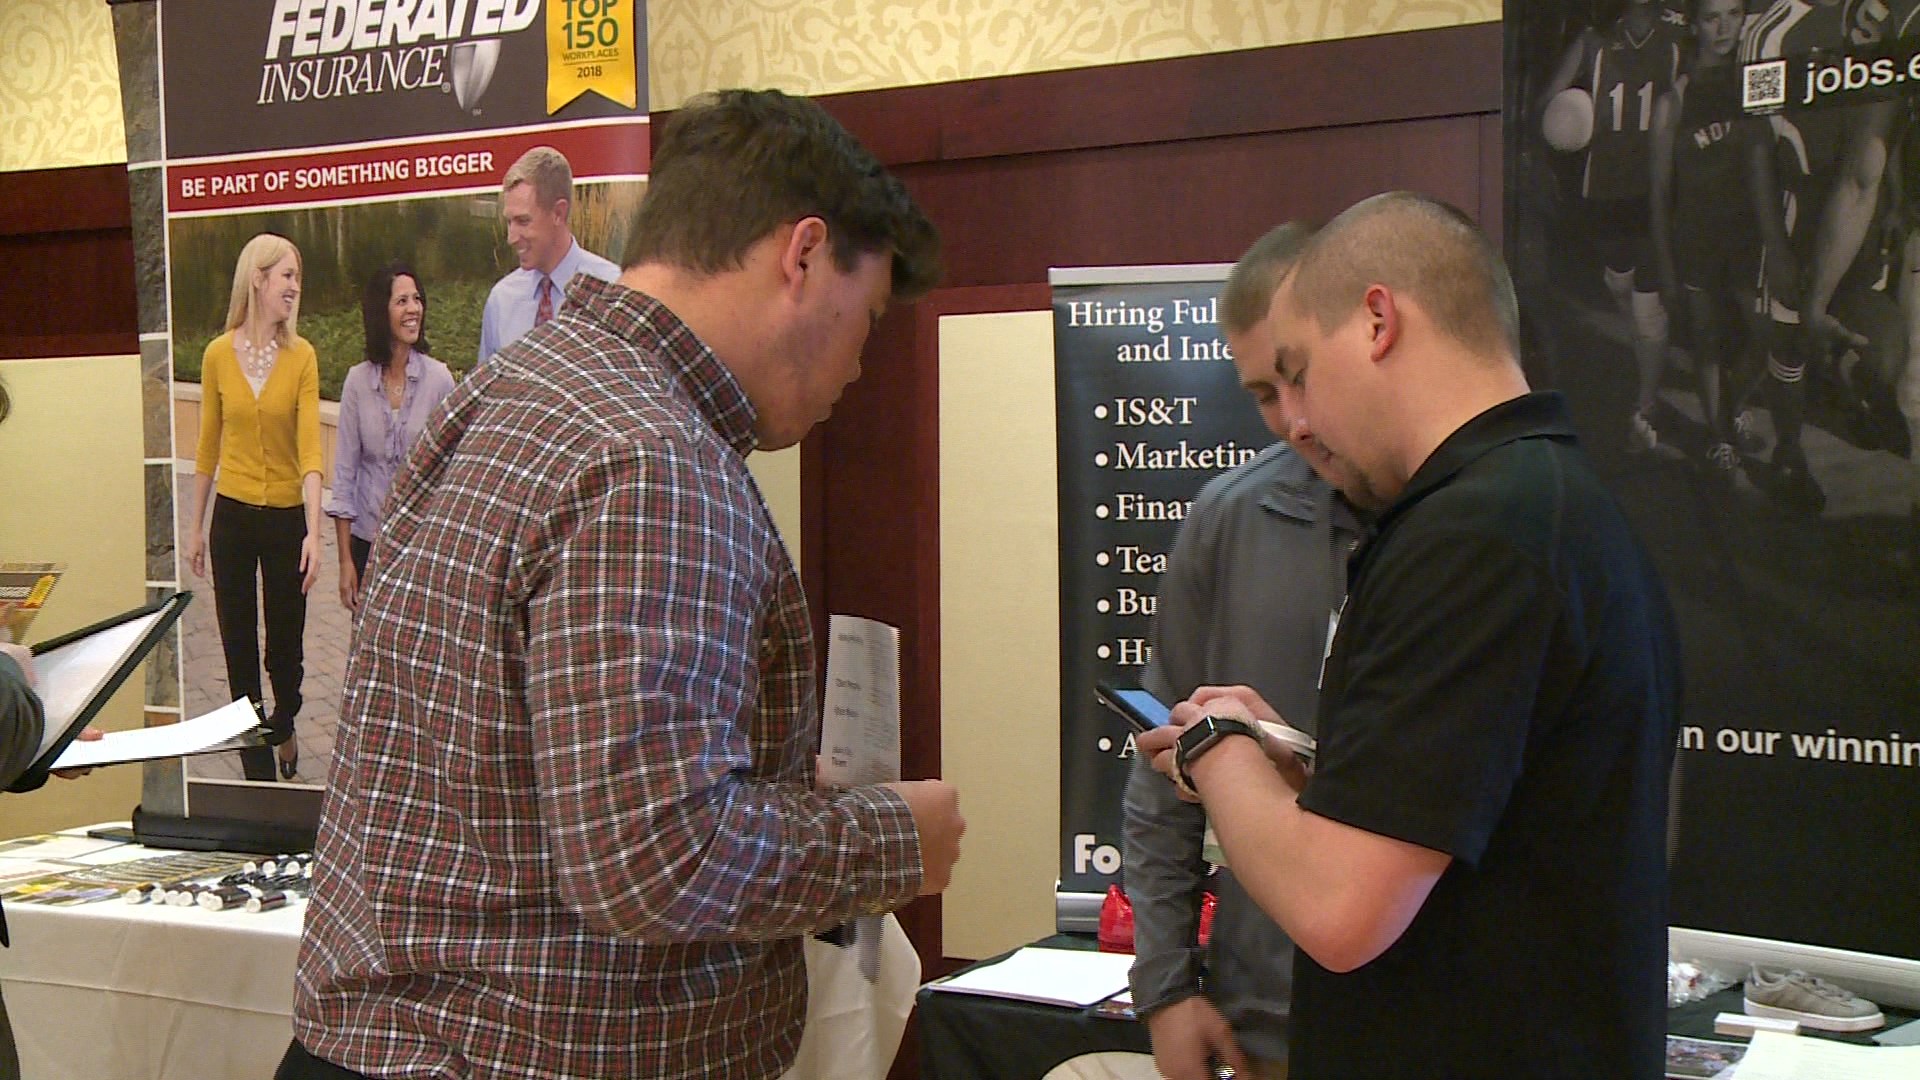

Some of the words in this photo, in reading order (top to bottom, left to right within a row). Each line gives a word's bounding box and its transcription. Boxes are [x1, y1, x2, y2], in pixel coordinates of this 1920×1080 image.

[561, 0, 618, 20] TOP
[265, 0, 541, 60] FEDERATED
[562, 18, 619, 50] 150
[562, 48, 619, 60] WORKPLACES
[257, 44, 449, 105] INSURANCE
[577, 66, 602, 78] 2018
[1803, 55, 1920, 104] jobs.e
[1609, 82, 1653, 131] 11
[181, 178, 206, 198] BE
[211, 173, 259, 196] PART
[264, 170, 290, 192] OF
[295, 159, 409, 190] SOMETHING
[415, 151, 494, 178] BIGGER
[1068, 300, 1164, 333] Hiring
[1172, 297, 1219, 325] Ful
[1117, 335, 1171, 363] and
[1179, 336, 1234, 361] Inte
[1114, 397, 1198, 426] IS&T
[1115, 440, 1264, 470] Marketin
[1116, 546, 1168, 574] Tea
[1116, 588, 1158, 616] Bu
[1716, 728, 1782, 755] our
[1791, 728, 1920, 767] winnin
[1074, 834, 1121, 875] Fo
